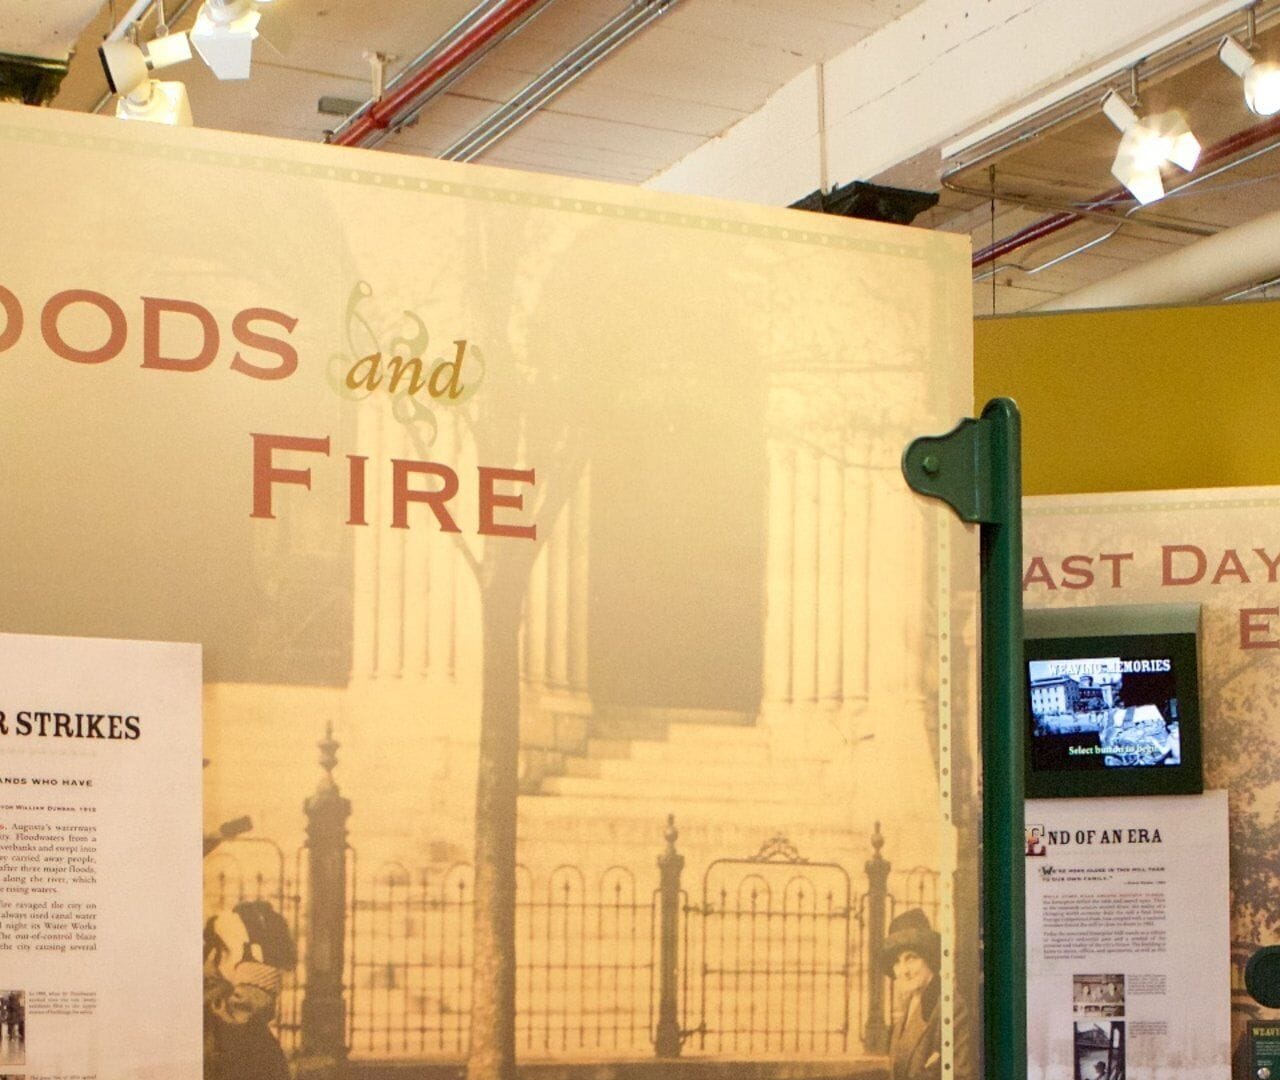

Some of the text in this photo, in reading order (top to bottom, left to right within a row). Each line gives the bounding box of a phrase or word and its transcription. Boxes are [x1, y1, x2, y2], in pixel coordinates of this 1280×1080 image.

[344, 340, 468, 400] and
[248, 432, 538, 541] FIRE
[1023, 552, 1134, 590] AST
[1107, 659, 1171, 673] MEMORIES
[15, 711, 141, 741] STRIKES
[1069, 745, 1093, 755] Select
[1075, 830, 1096, 844] OF
[1100, 829, 1122, 844] AN
[1128, 829, 1163, 843] ERA
